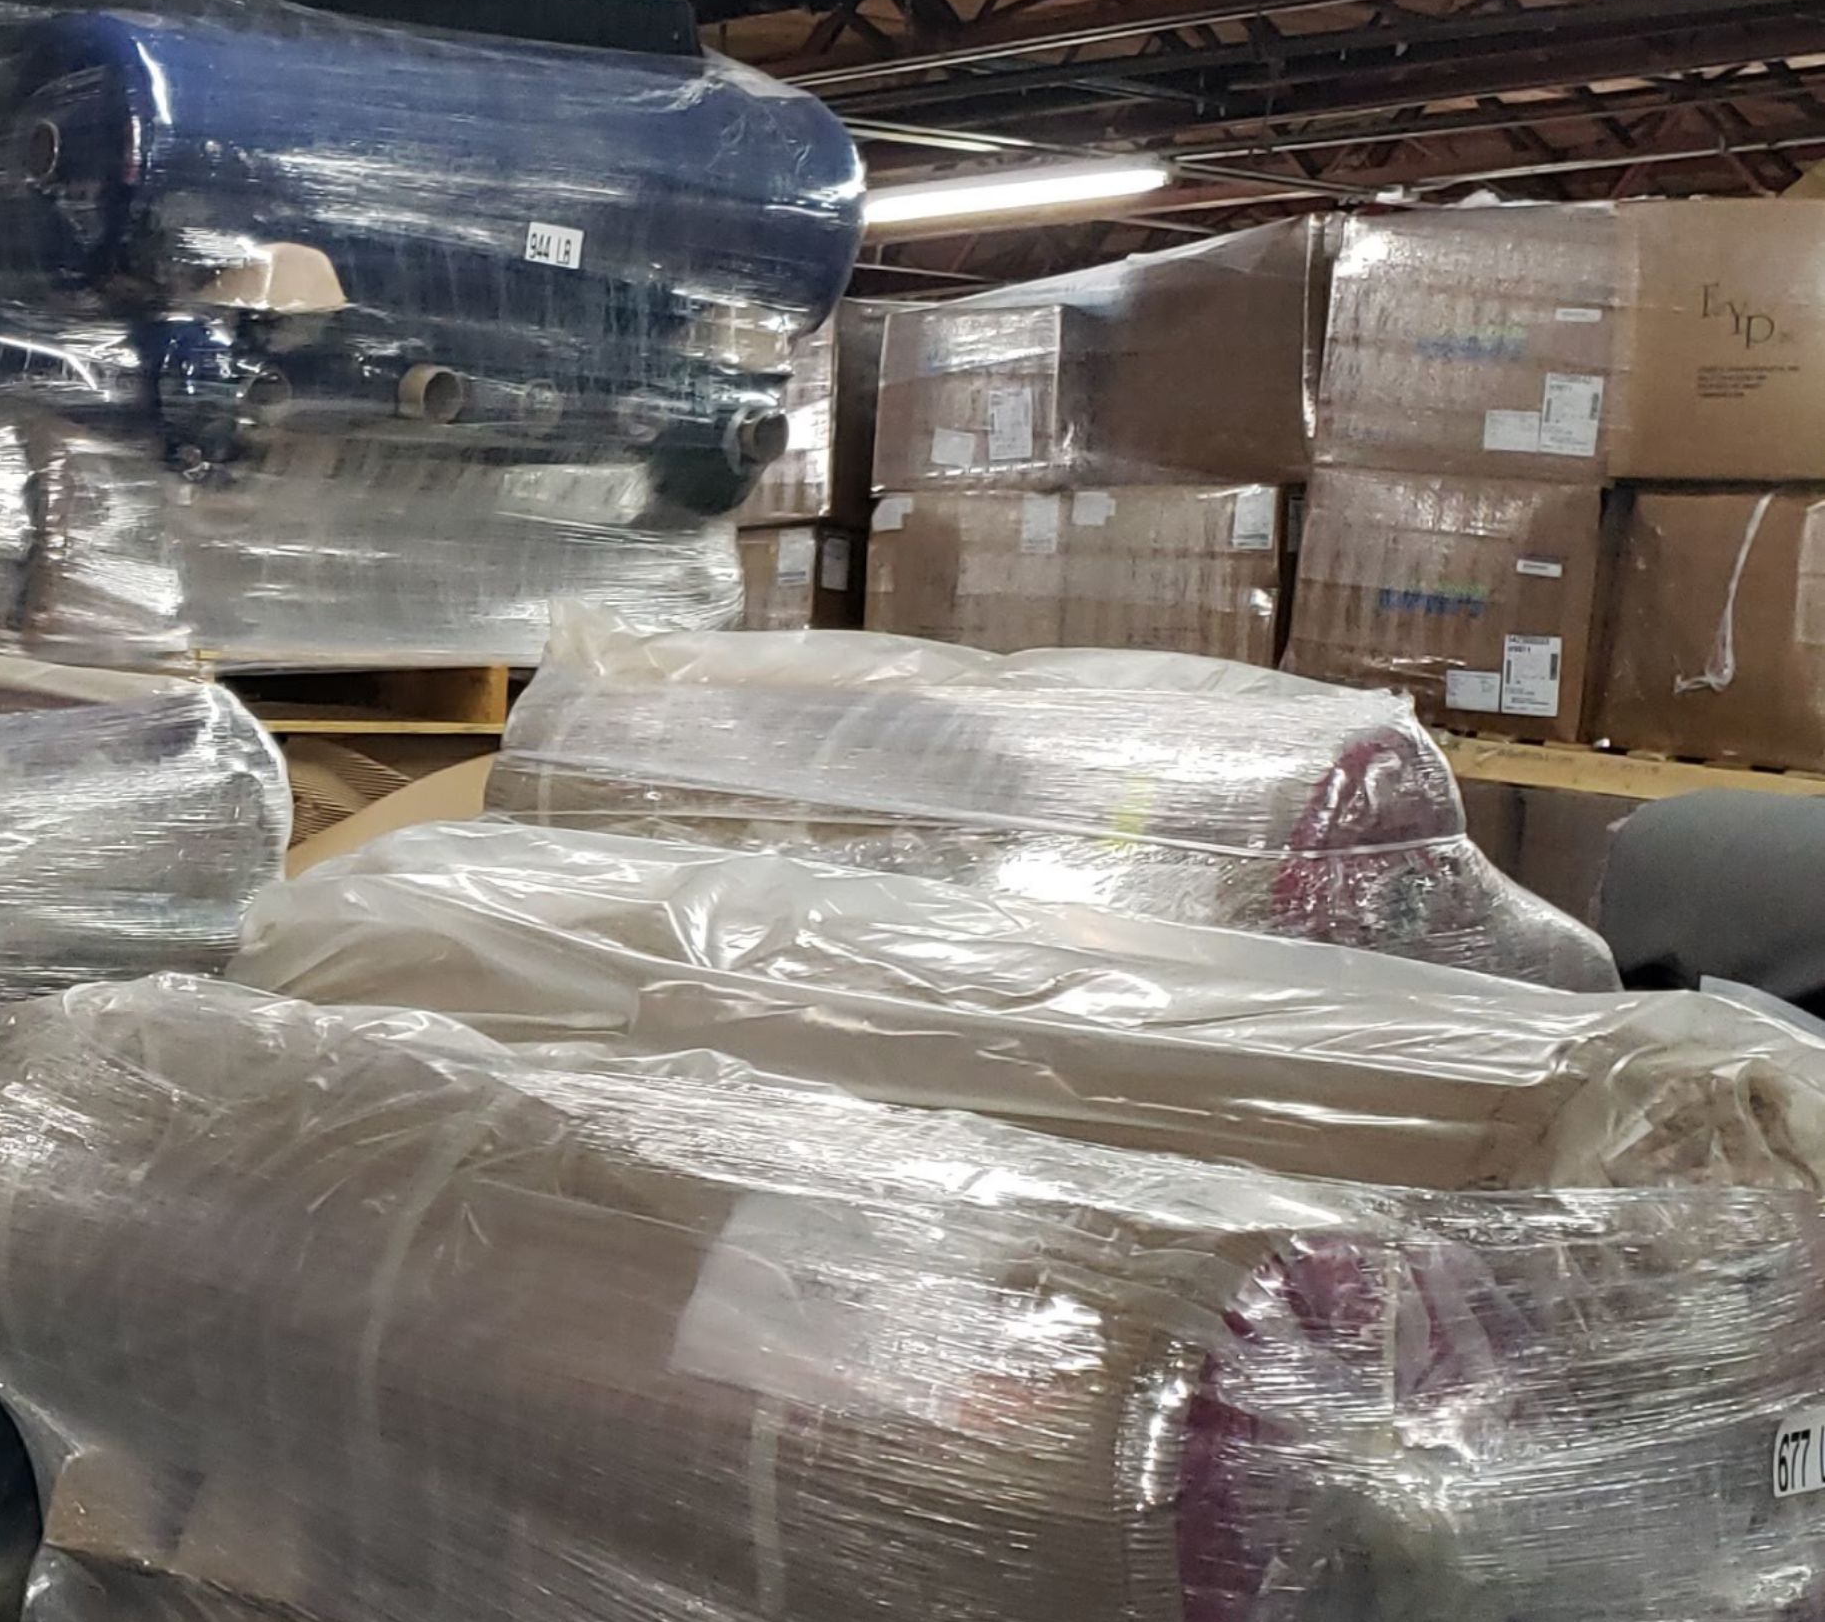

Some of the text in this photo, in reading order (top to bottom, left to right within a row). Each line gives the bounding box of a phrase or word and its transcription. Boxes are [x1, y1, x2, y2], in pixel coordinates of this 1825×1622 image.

[529, 233, 571, 265] 944 LB
[1778, 1428, 1811, 1492] 677
